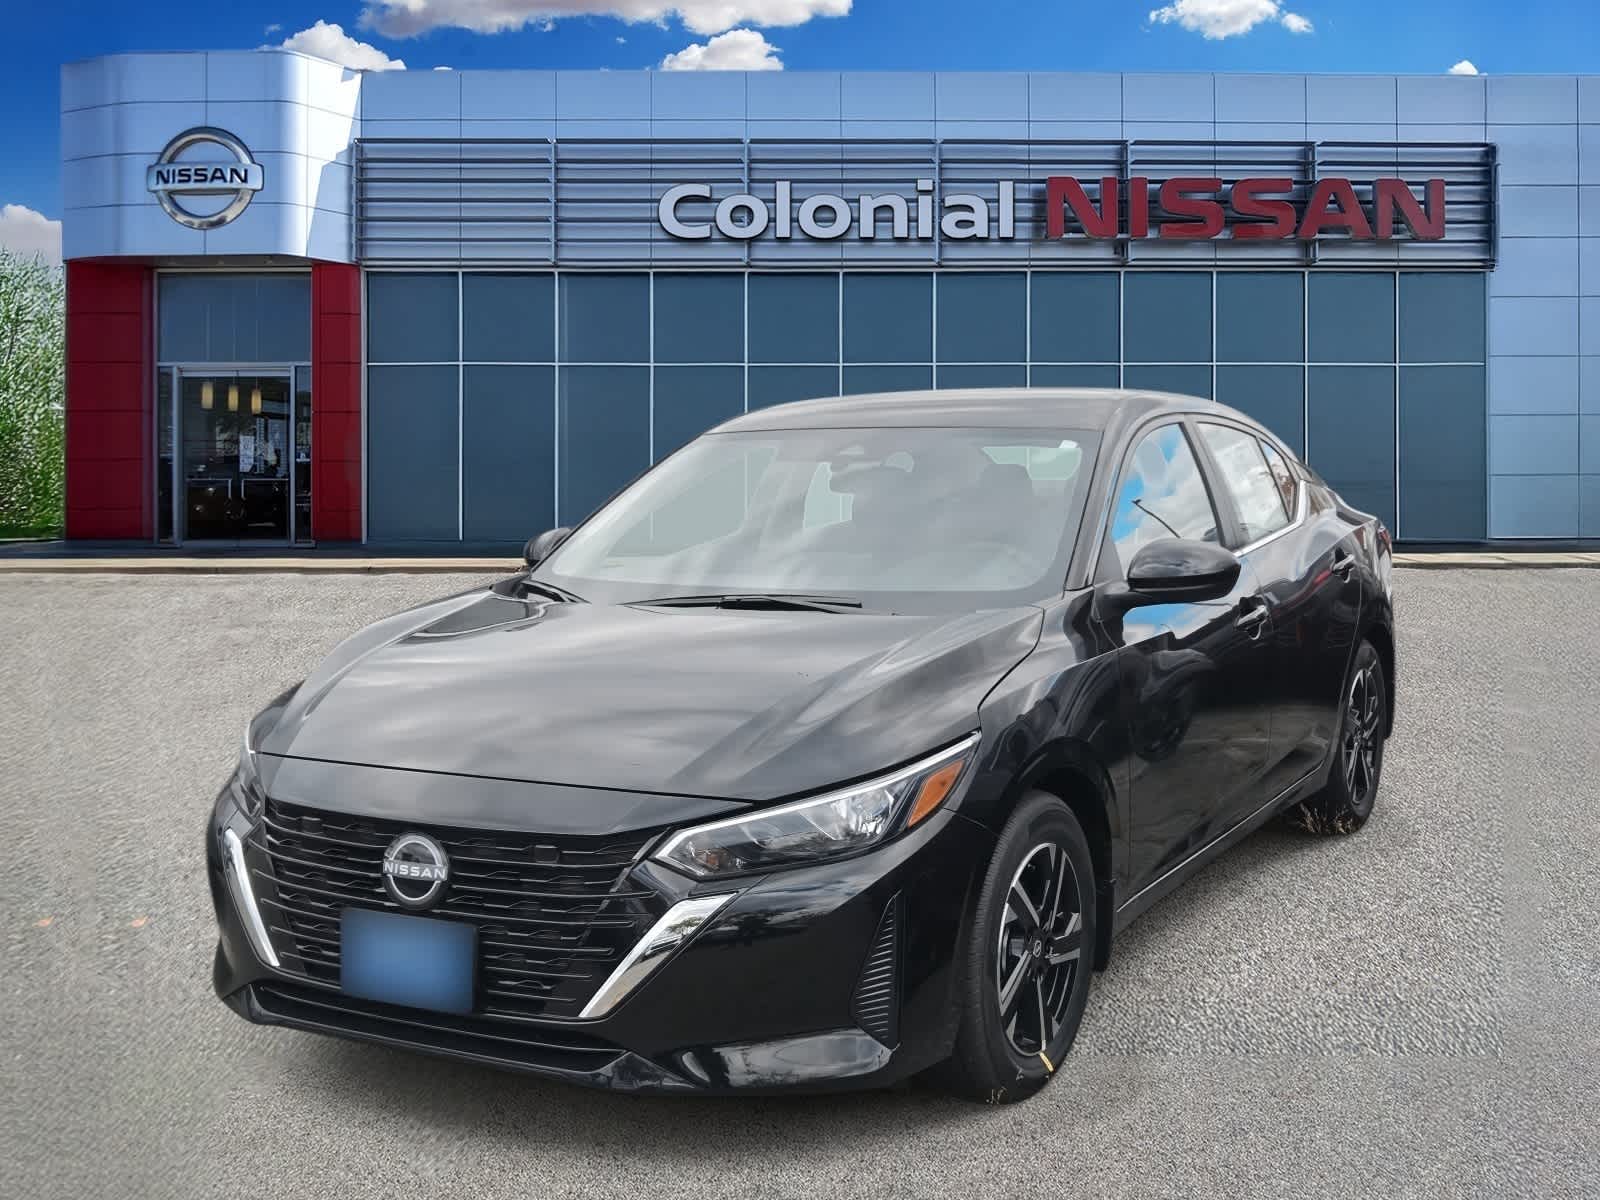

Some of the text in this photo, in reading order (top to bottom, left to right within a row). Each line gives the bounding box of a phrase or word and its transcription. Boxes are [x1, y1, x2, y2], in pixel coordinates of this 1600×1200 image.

[155, 167, 249, 185] NISSAN
[657, 175, 1447, 241] Colonial NISSAN
[384, 861, 446, 879] NISSAN
